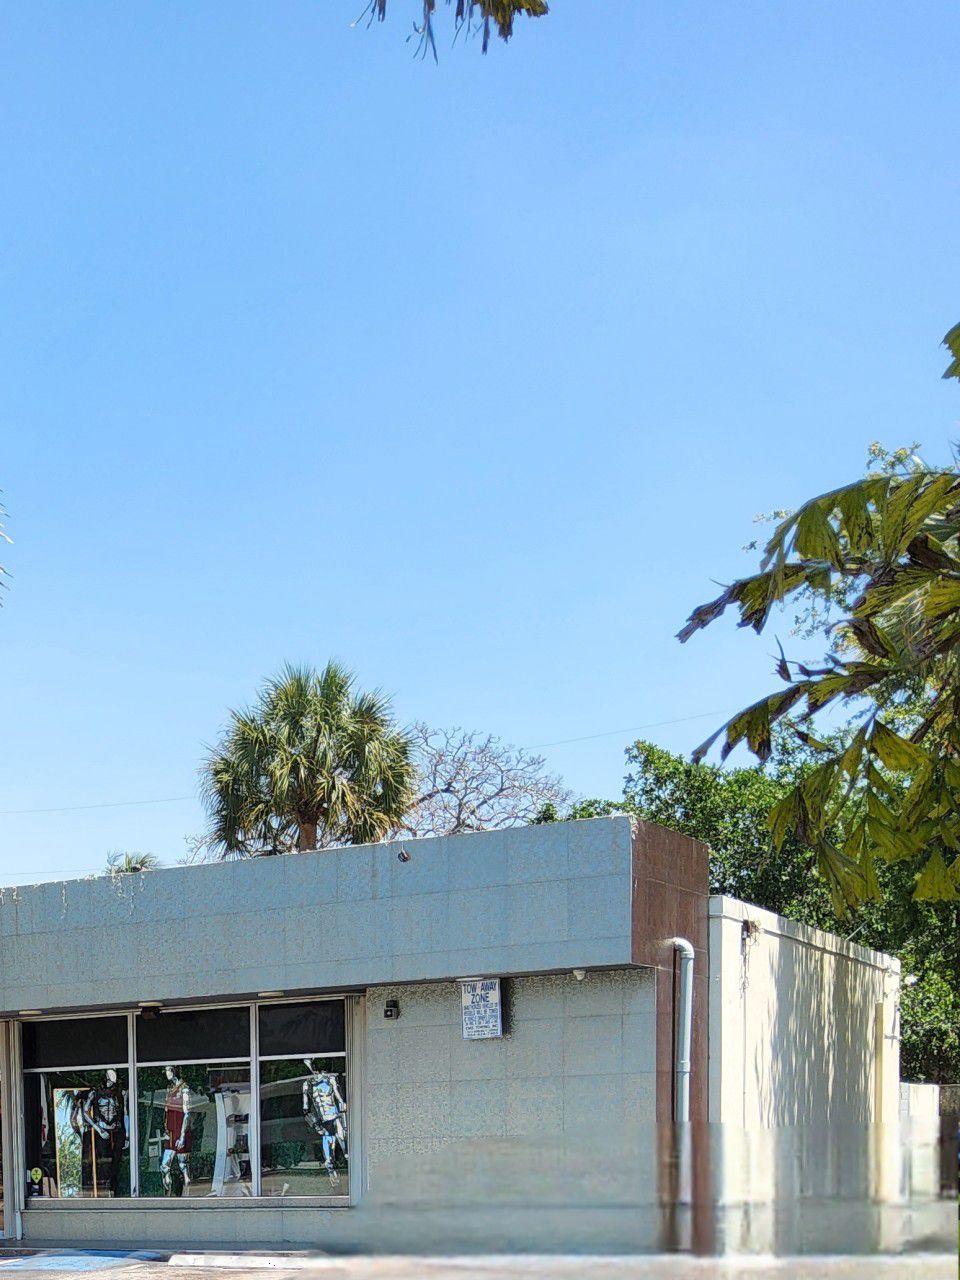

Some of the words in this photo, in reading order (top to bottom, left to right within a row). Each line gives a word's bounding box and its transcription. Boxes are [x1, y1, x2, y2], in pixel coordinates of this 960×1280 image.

[463, 982, 477, 994] TOW
[481, 981, 497, 992] AWAY
[471, 992, 490, 1004] ZONE
